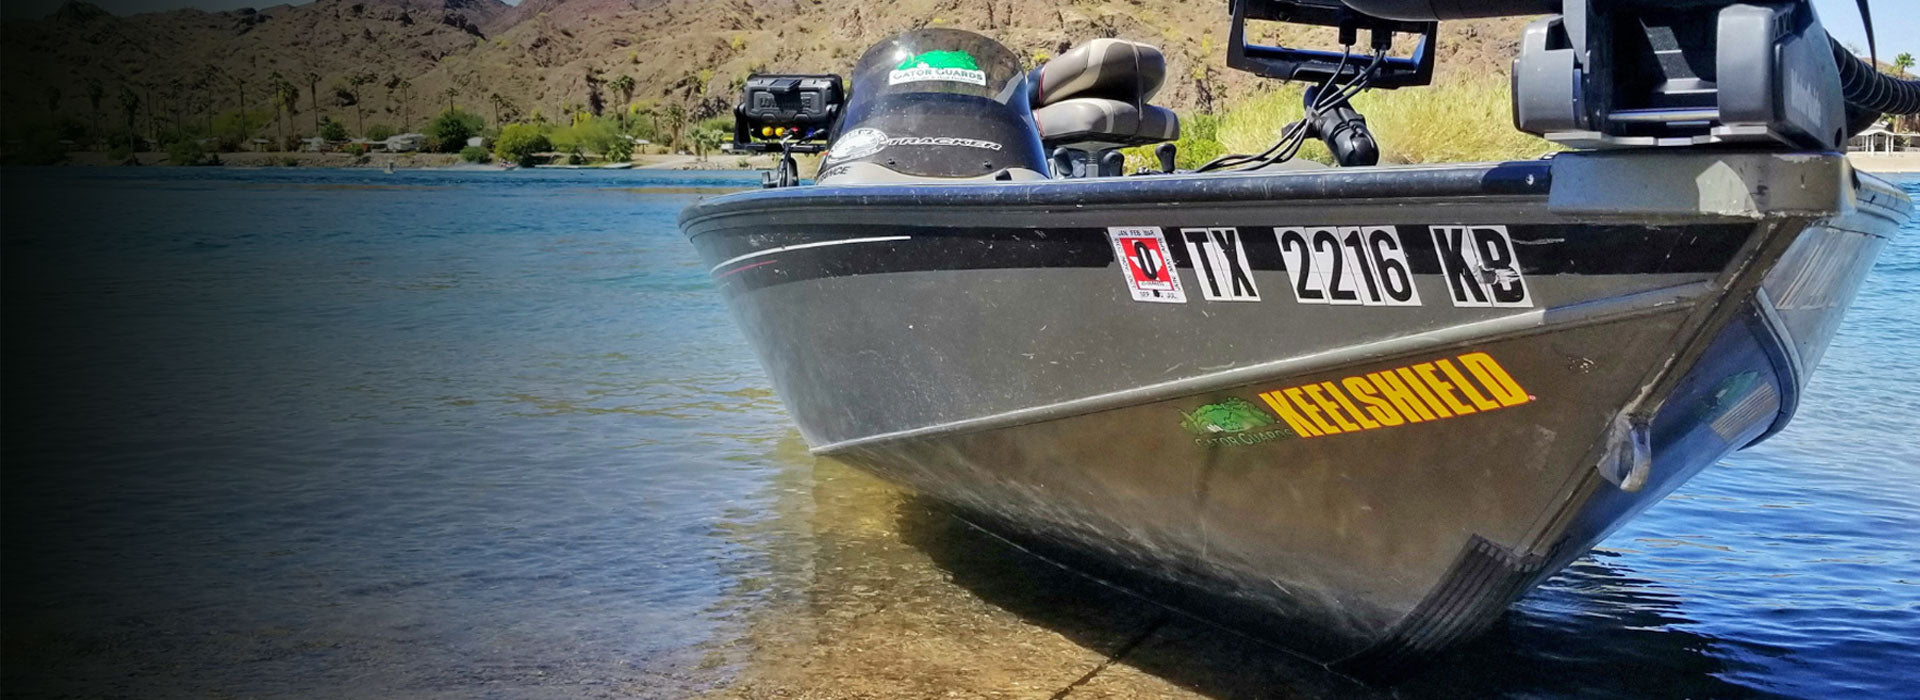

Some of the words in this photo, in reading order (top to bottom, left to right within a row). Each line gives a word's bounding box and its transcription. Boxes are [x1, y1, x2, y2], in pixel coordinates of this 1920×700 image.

[935, 69, 983, 81] GUARDS
[887, 137, 1003, 151] TRACKER
[1184, 229, 1258, 297] TX
[1281, 229, 1412, 302] 2216
[1432, 228, 1525, 303] KB
[1258, 352, 1531, 438] KEELSHIELD
